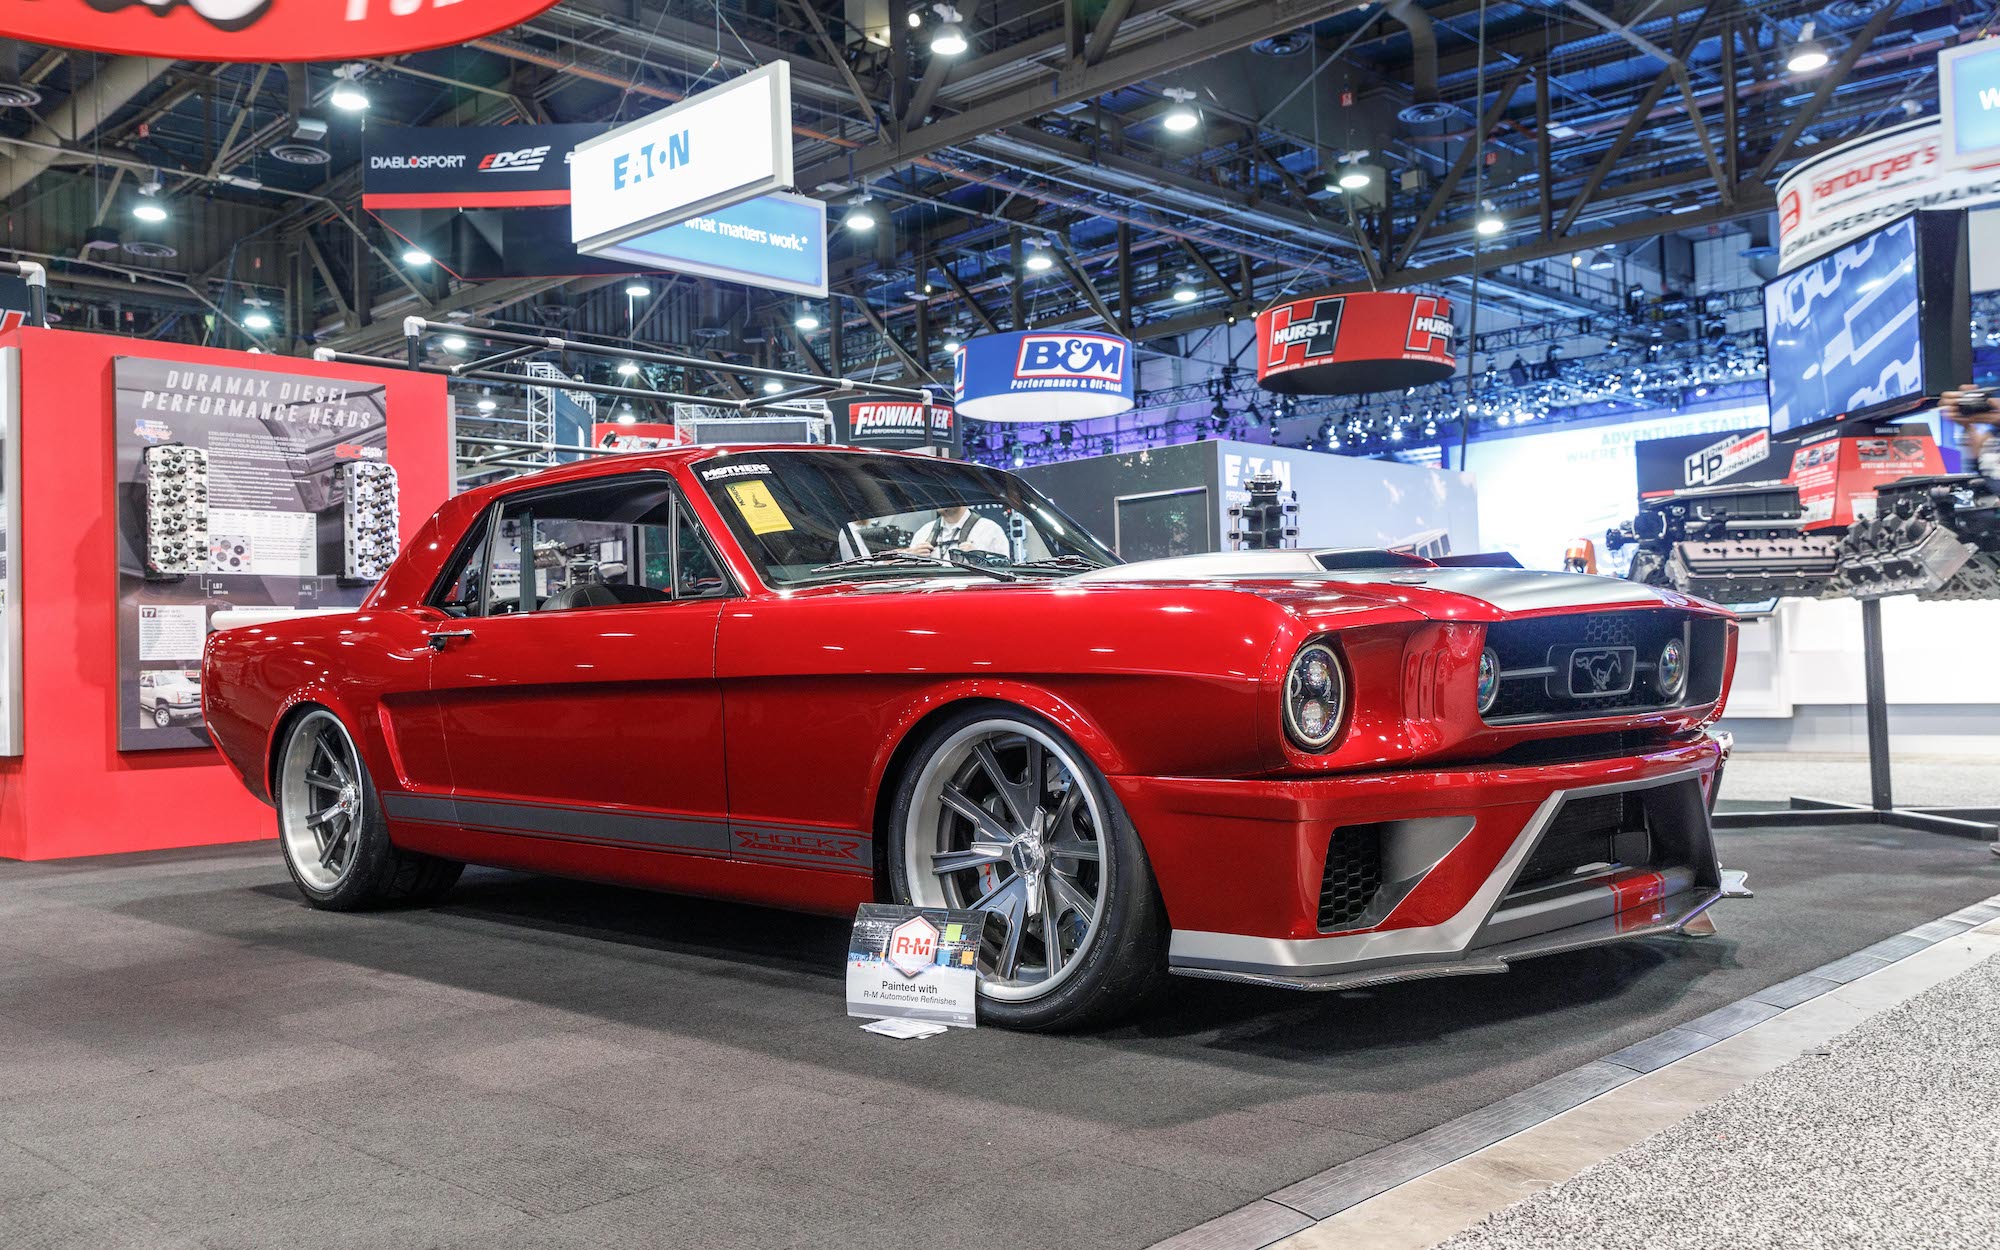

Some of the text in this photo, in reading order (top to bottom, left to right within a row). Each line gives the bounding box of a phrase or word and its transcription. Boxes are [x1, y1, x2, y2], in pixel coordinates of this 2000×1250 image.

[371, 154, 466, 169] DIABLOSPORT
[478, 145, 551, 171] EDGE
[613, 129, 690, 191] EATON
[719, 221, 768, 244] matters
[1273, 320, 1333, 345] HURST
[1415, 317, 1454, 338] HURST
[1020, 339, 1122, 375] B&M
[166, 370, 348, 407] DURAMAX DIESEL
[1010, 378, 1078, 390] Performance
[1080, 380, 1087, 388] &
[142, 391, 372, 430] PERFORMANCE HEADS
[855, 405, 950, 436] FLOWMATER
[701, 464, 771, 480] MOTHERS
[142, 608, 156, 618] T7
[896, 936, 931, 956] R-M
[863, 990, 957, 1006] R-M Automotive Refinishes
[882, 981, 938, 994] Painted with
